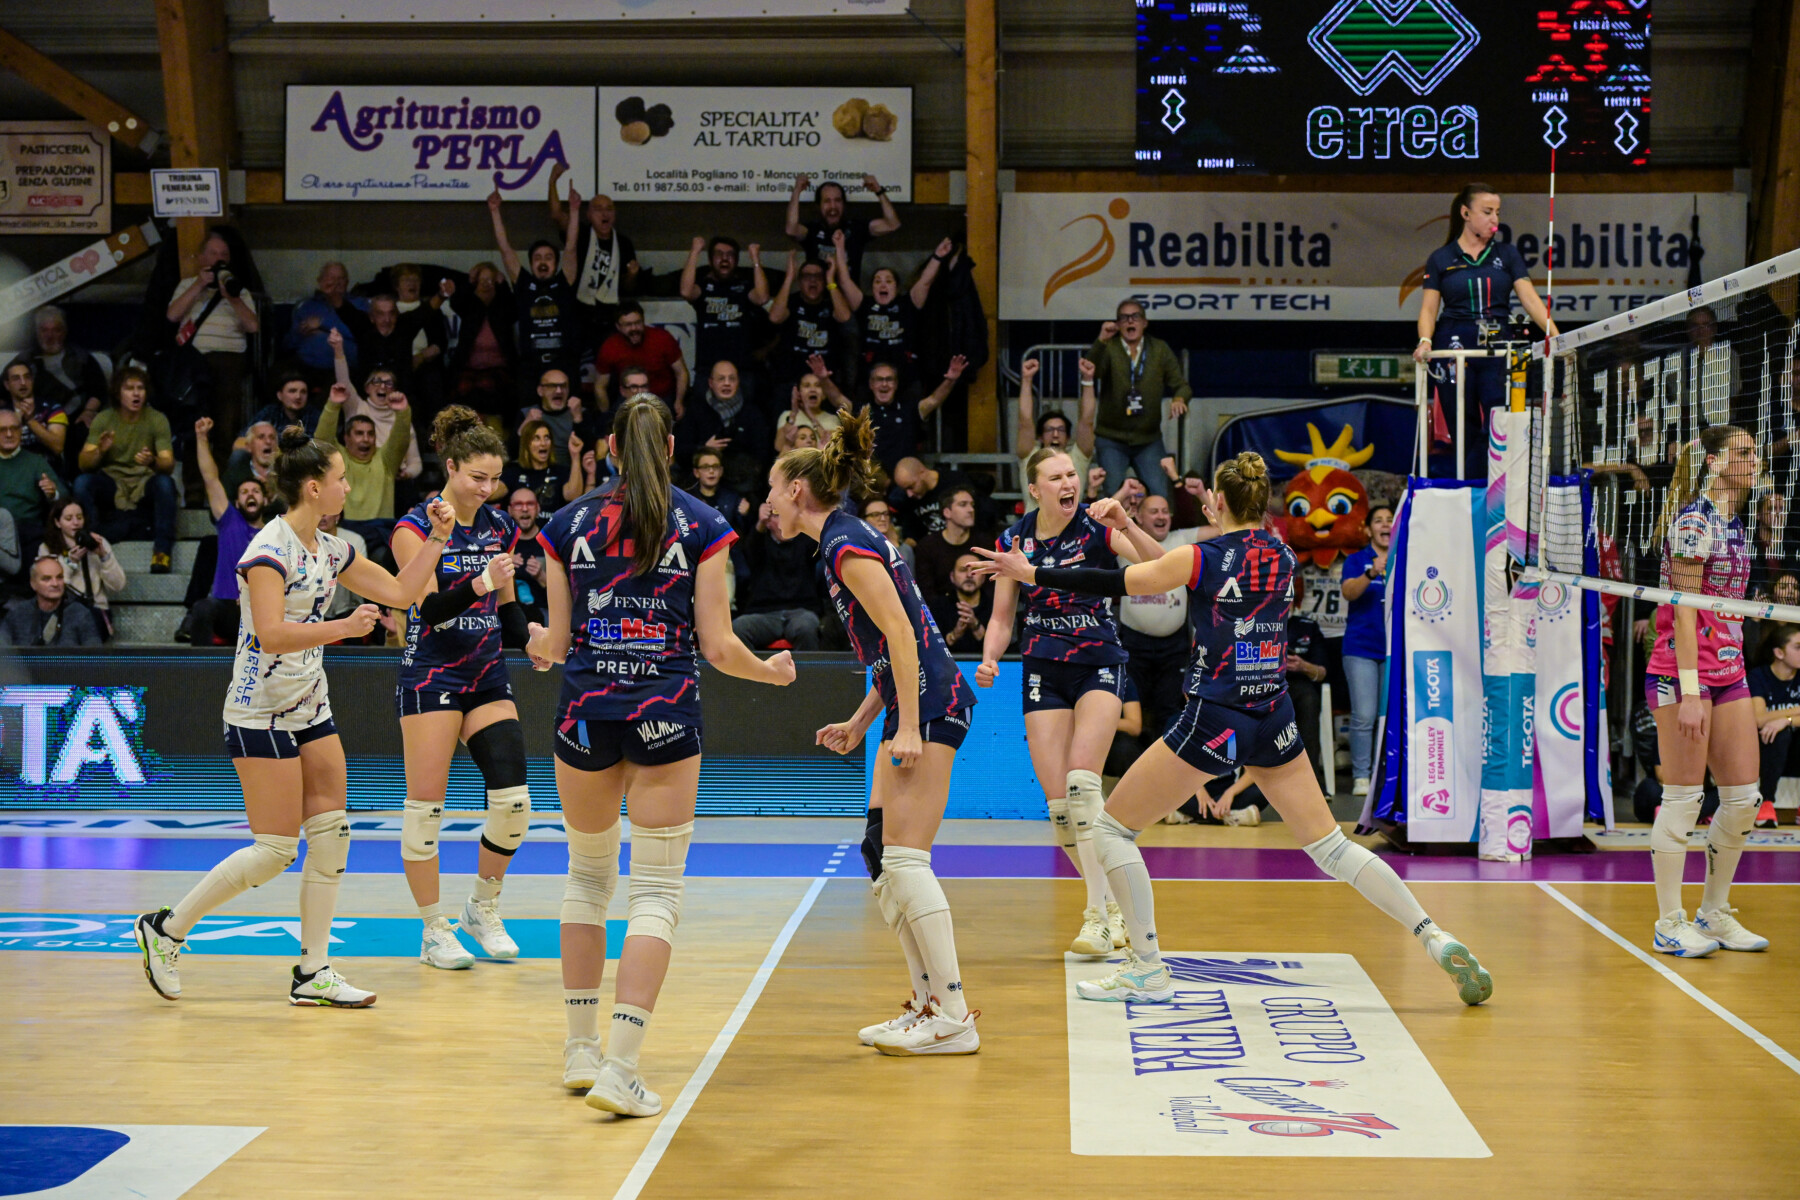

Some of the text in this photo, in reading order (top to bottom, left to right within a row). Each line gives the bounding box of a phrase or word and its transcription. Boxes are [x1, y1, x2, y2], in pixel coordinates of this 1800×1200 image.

[310, 90, 541, 151] Agriturismo
[700, 110, 820, 128] SPECIALITA'
[20, 144, 90, 155] PASTICCERIA
[693, 130, 821, 147] AL TARTUFO
[16, 165, 95, 176] PREPARAZIONI
[412, 129, 570, 190] PERLA
[18, 177, 93, 187] SENZA GLUTINE
[168, 174, 203, 182] TRIBUNA
[646, 168, 688, 179] Località
[691, 169, 739, 182] Pogliano
[741, 169, 755, 179] 10
[162, 184, 211, 192] FENERA SUD
[612, 182, 631, 192] Tel.
[633, 182, 652, 192] 011
[654, 182, 705, 192] 987.50.03
[714, 182, 750, 192] e-mail:
[1129, 221, 1331, 267] Reabilita
[1130, 294, 1330, 311] SPORT TECH
[570, 506, 589, 535] VALMORA
[673, 507, 691, 538] VALMORA
[1221, 548, 1236, 572] VALMORA
[1245, 548, 1281, 591] 17
[658, 567, 690, 577] DRIVALIA
[614, 596, 668, 610] FENERA
[1312, 589, 1341, 615] 76
[588, 618, 668, 643] BigMat
[596, 660, 660, 676] PREVIA
[241, 656, 259, 706] REALE
[1029, 687, 1041, 702] 4
[557, 729, 591, 755] DRIVALIA
[1201, 745, 1234, 766] DRIVALIA
[1428, 726, 1436, 784] LEGA VOLLEY
[1437, 729, 1445, 780] FEMMINILE
[1260, 996, 1366, 1064] GRUPPO
[1159, 1095, 1229, 1135] Volleyball
